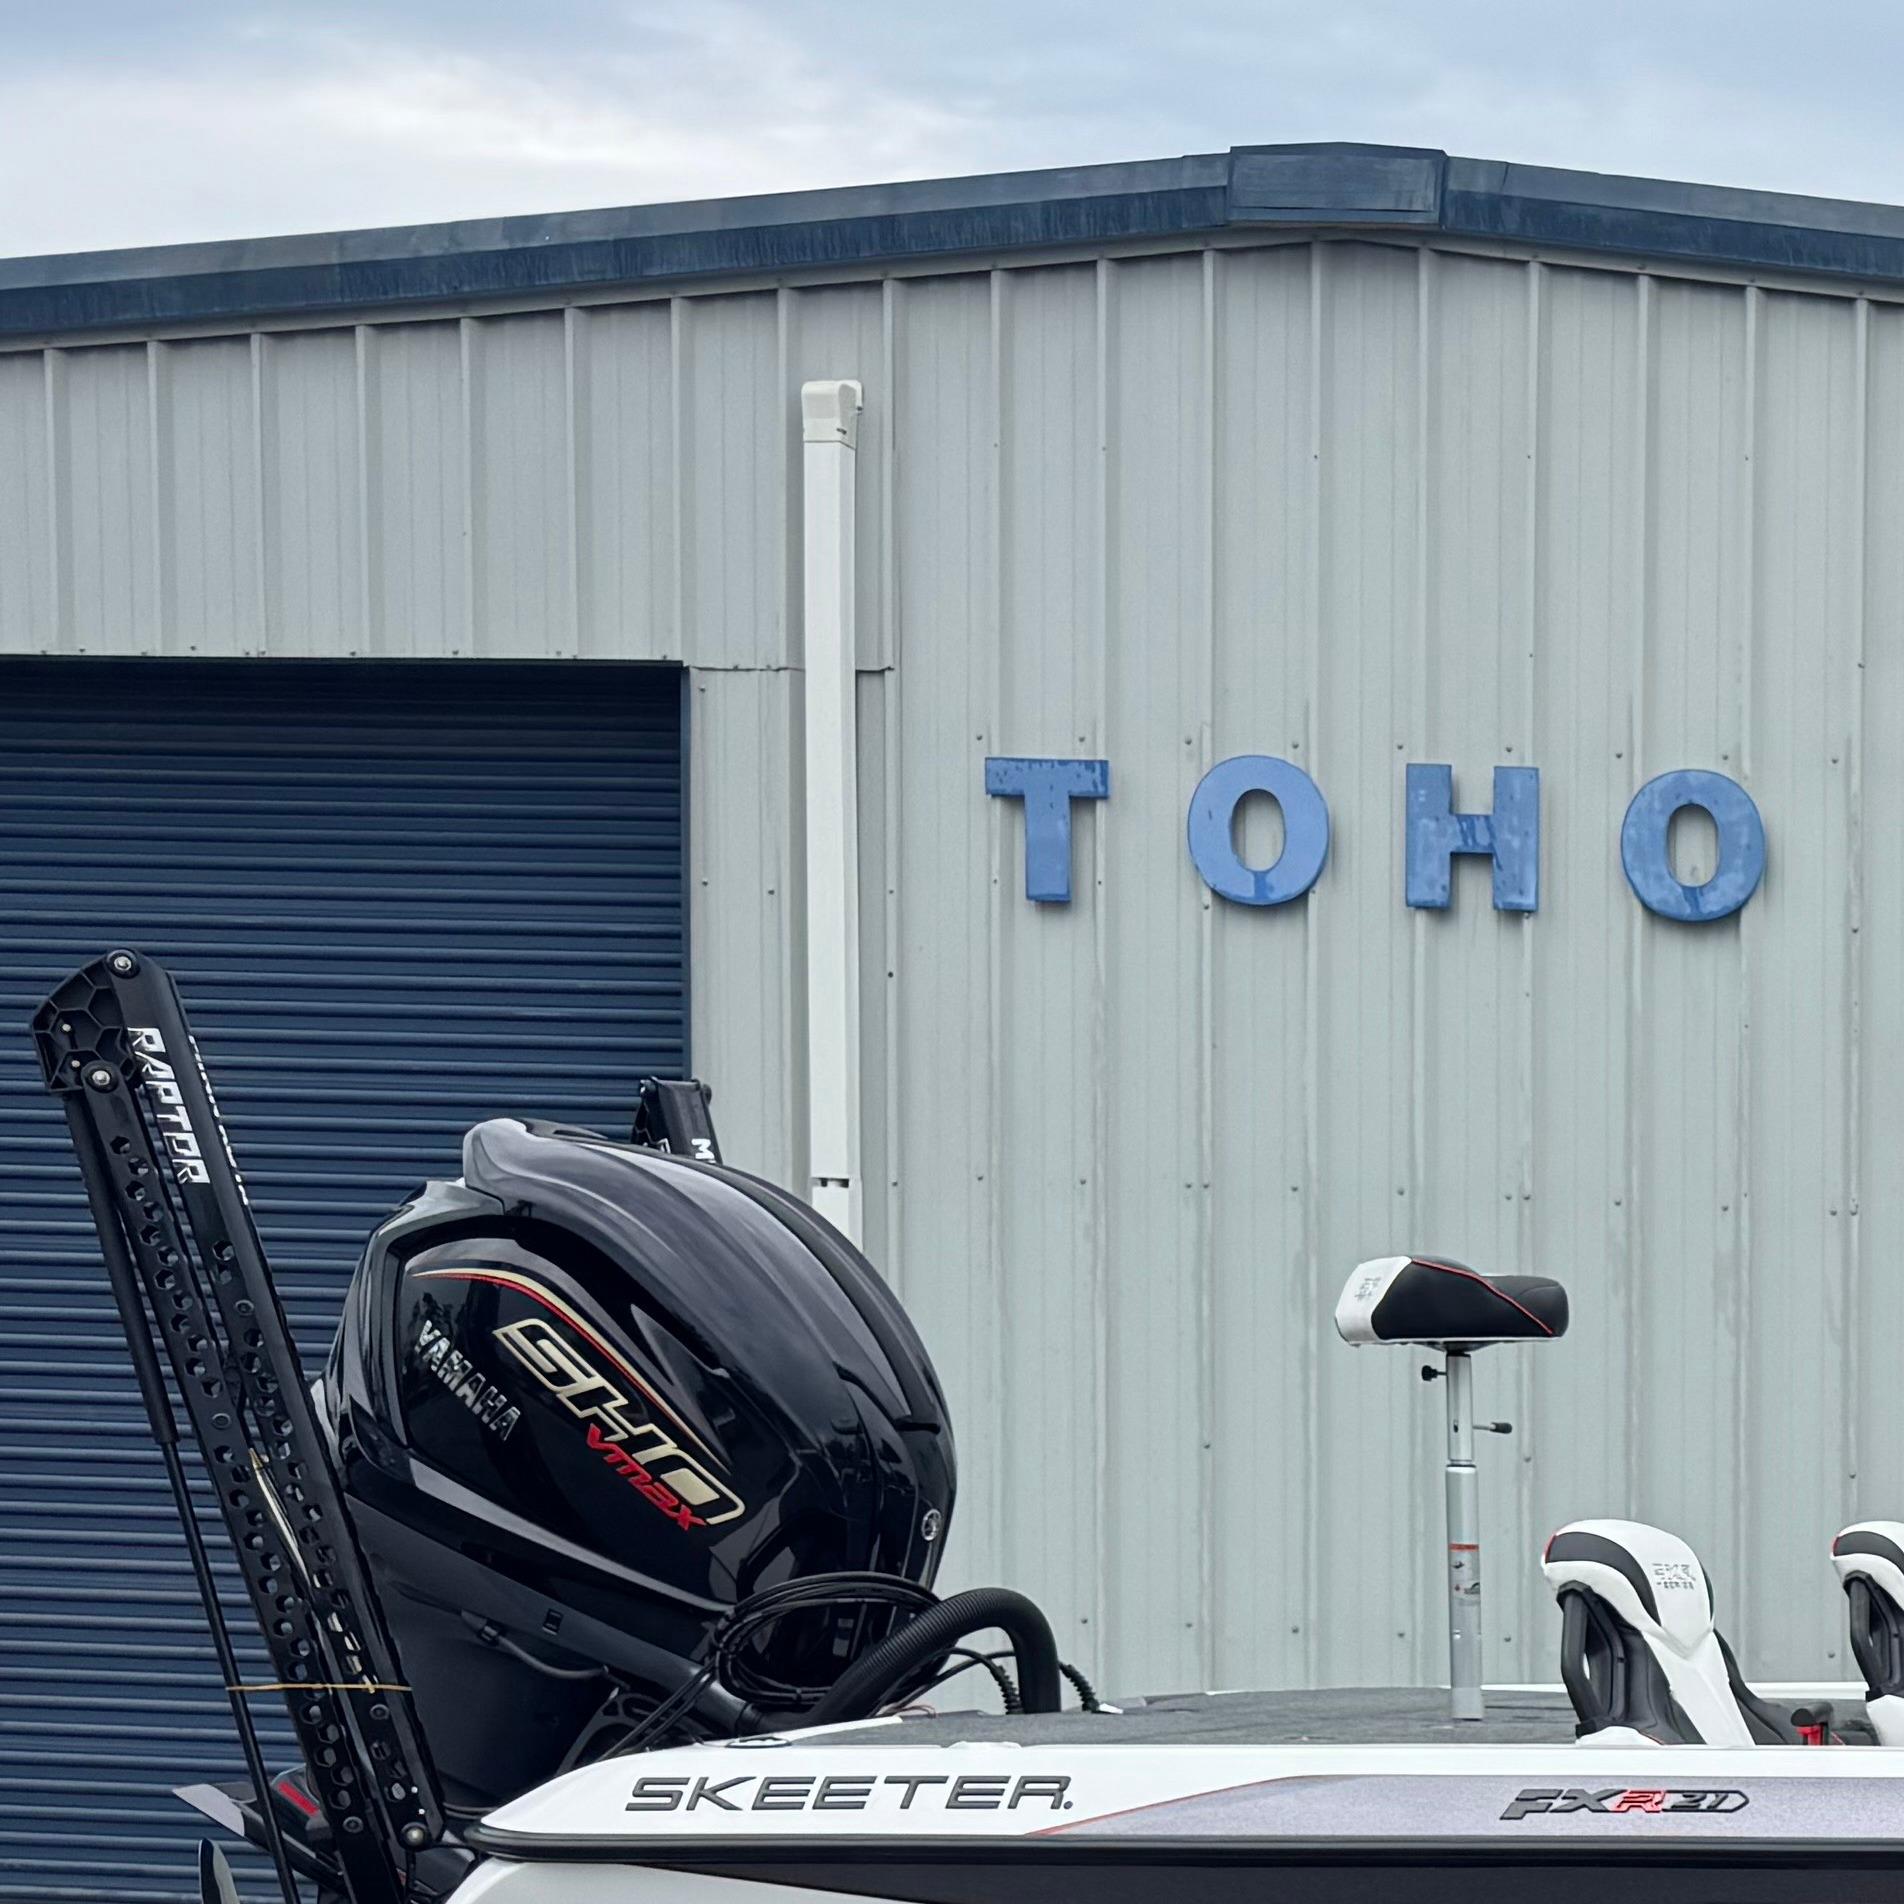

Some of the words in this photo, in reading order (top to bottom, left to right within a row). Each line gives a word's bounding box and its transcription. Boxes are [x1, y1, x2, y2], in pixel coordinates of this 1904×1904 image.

[985, 755, 1765, 922] TOHO
[127, 1027, 210, 1184] RAPTOR
[414, 1319, 521, 1442] YAMAHA
[492, 1318, 745, 1525] SHO
[625, 1775, 1072, 1812] SKEETER
